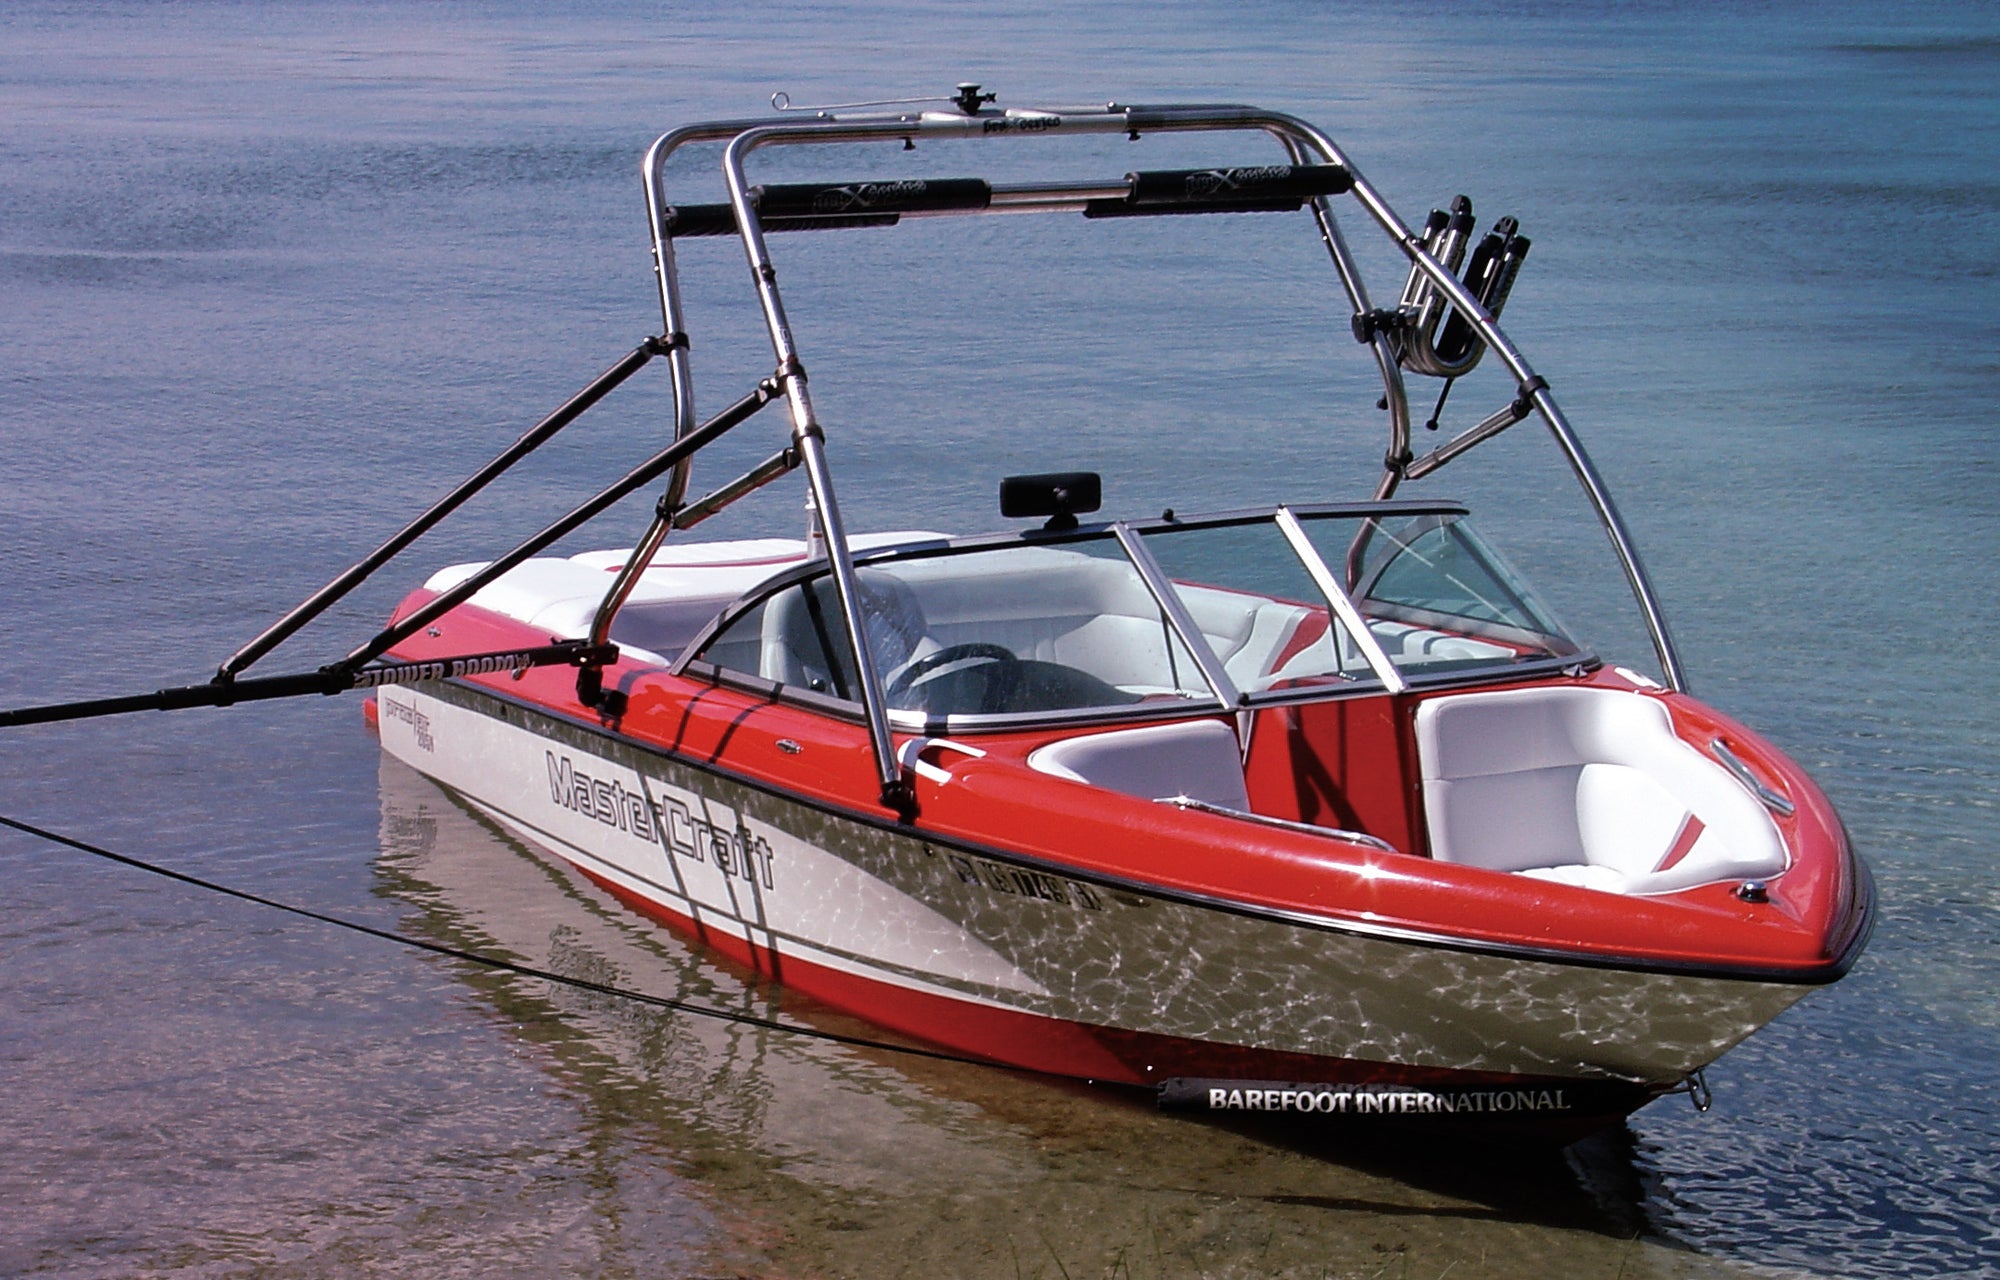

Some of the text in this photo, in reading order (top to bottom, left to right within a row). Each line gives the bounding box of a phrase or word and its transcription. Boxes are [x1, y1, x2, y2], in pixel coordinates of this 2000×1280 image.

[371, 662, 445, 687] TOWER
[452, 653, 515, 678] BOOM
[546, 750, 775, 890] MasterCraft
[1208, 1088, 1572, 1114] BAREFOOT INTERNATIONAL
